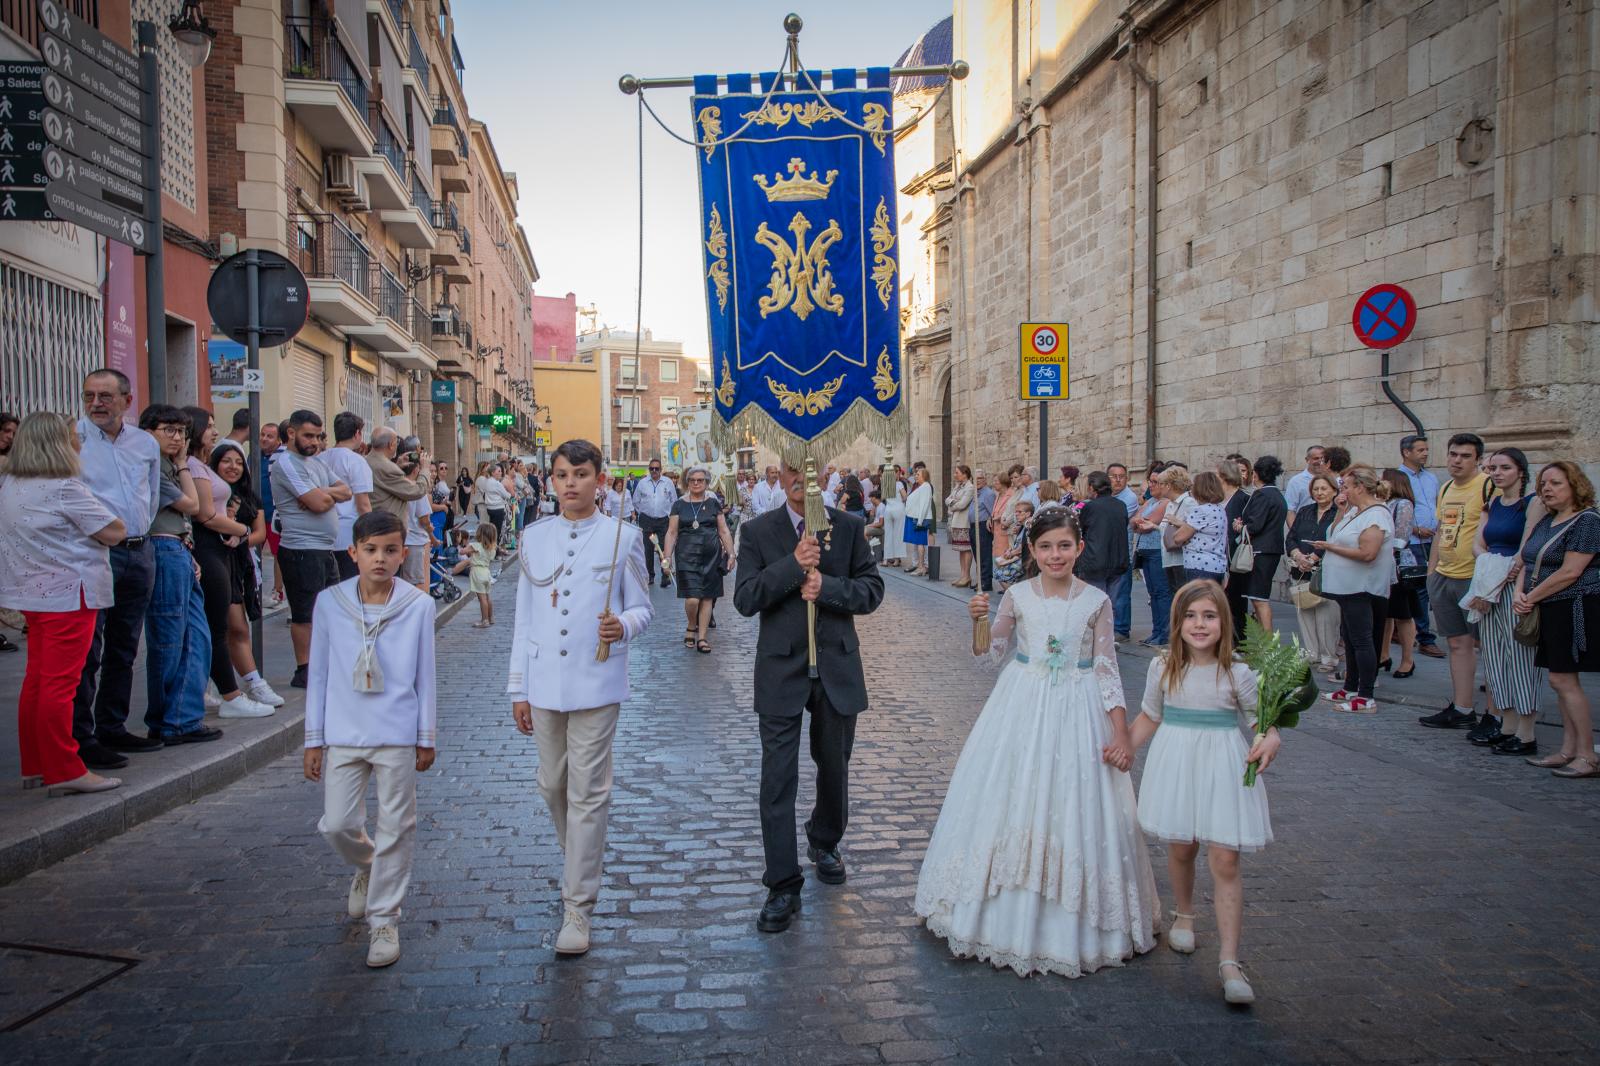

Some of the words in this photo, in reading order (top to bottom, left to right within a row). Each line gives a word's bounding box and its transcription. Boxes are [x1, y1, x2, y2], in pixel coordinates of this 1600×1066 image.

[81, 39, 96, 56] San
[97, 50, 114, 68] Juan
[115, 62, 124, 74] de
[125, 67, 140, 85] Dios
[103, 40, 116, 55] sala
[118, 50, 139, 70] museo
[81, 72, 90, 85] de
[100, 82, 140, 114] Reconquista
[118, 81, 140, 100] museo
[85, 110, 115, 136] Santiago
[120, 114, 141, 134] iglesia
[92, 151, 102, 163] de
[103, 154, 142, 182] Monserrate
[110, 145, 142, 168] santuario
[80, 167, 106, 185] palacio
[108, 177, 143, 201] Rubalcava
[53, 194, 75, 211] OTROS
[76, 204, 119, 230] MONUMENTOS
[1036, 335, 1055, 347] 30
